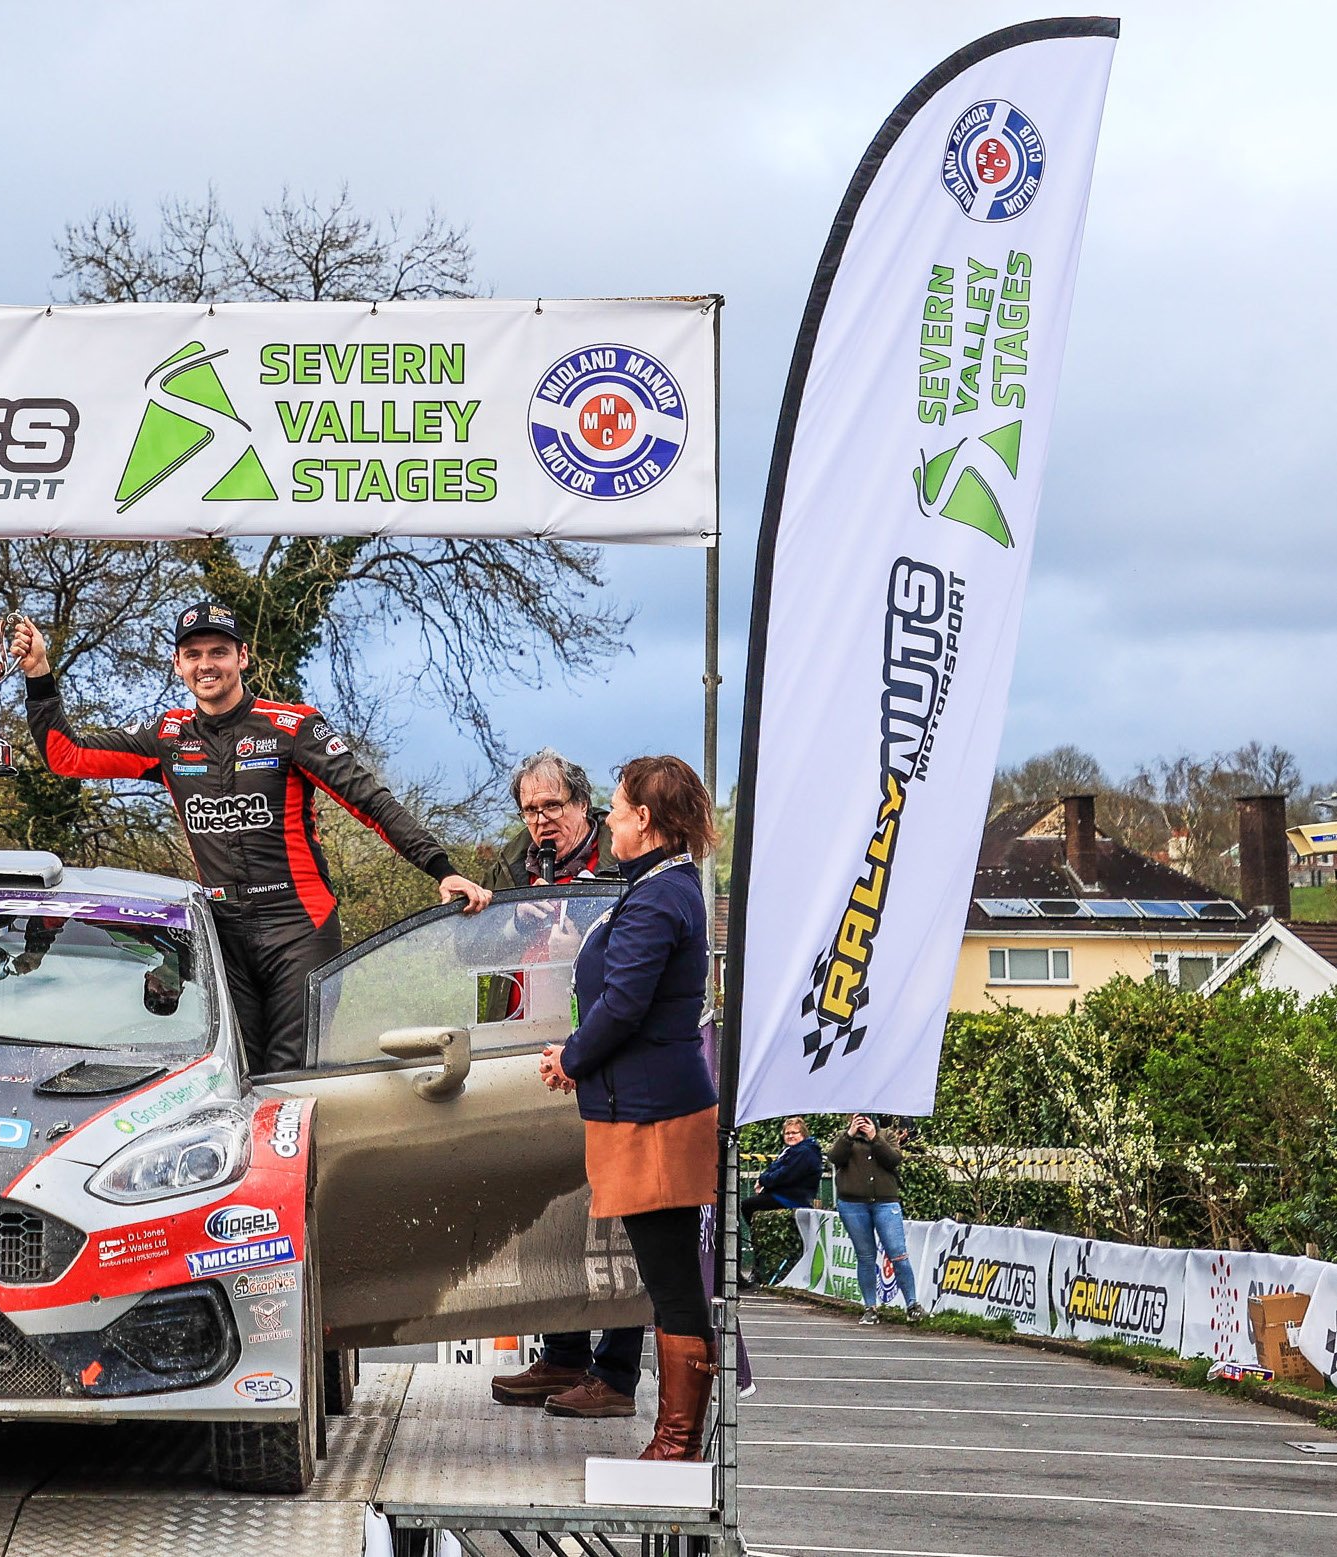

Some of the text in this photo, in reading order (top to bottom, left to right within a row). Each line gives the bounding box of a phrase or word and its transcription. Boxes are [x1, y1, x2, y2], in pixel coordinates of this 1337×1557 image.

[945, 107, 989, 210] MIDLAND MANOR
[1003, 125, 1042, 215] MOTOR CLUB
[917, 264, 954, 426] SEVERN
[952, 258, 998, 416] VALLEY
[992, 250, 1032, 409] STAGES
[260, 344, 464, 384] SEVERN
[541, 350, 678, 411] MIDLAND MANOR
[276, 401, 481, 442] VALLEY
[292, 459, 497, 502] STAGES
[541, 443, 663, 492] MOTOR CLUB
[915, 571, 967, 782] MOTORSPORT
[276, 717, 297, 727] OMP
[187, 796, 265, 815] demon
[820, 560, 943, 1021] RALLYNUTS
[189, 811, 272, 831] tweeks
[247, 882, 289, 894] OSIAN PRYCE
[129, 1239, 166, 1252] Wales Ltd
[143, 1229, 165, 1238] Jones
[203, 1239, 289, 1268] MICHELIN
[250, 1278, 295, 1294] Graphics
[1069, 1278, 1166, 1332] RALLYNUTS
[245, 1381, 281, 1391] RSC
